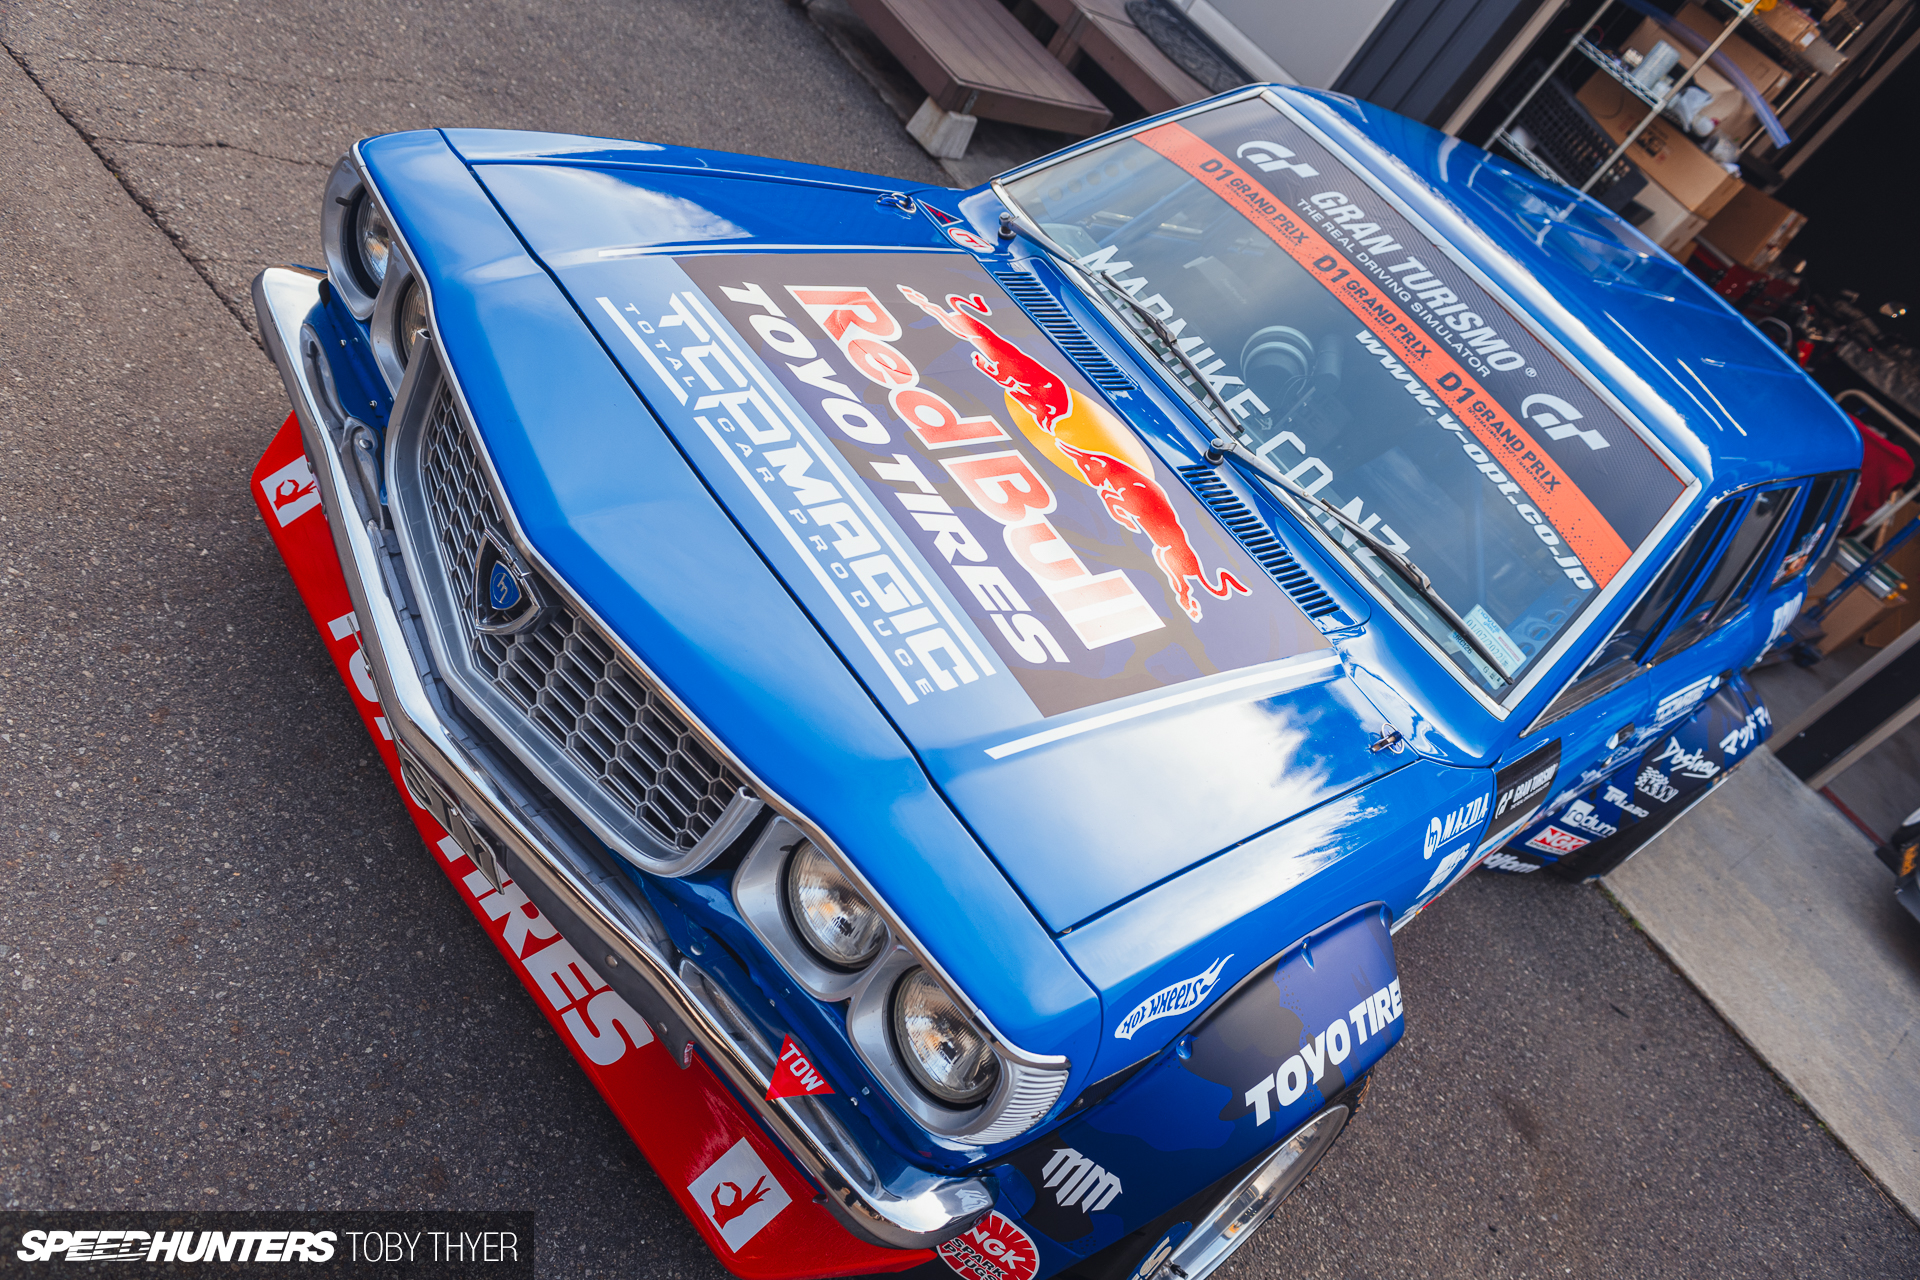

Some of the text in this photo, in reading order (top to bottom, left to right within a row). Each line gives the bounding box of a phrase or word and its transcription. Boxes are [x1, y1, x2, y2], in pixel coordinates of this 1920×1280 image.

[1199, 158, 1310, 245] D1 GRAND PRIX
[1296, 198, 1491, 378] THE REAL DRIVING SIMULATOR
[1309, 190, 1526, 372] GRAN TURISMO
[1312, 255, 1432, 360] D1 GRAND PRIX
[718, 281, 1071, 664] TOYO TIRES
[785, 284, 1167, 651] Red Bull
[1354, 329, 1595, 590] www.v-opt.co.jp
[1436, 371, 1562, 492] D1 GRAND PRIX
[624, 302, 935, 696] TOTAL CAR PRODUCE
[1440, 792, 1490, 842] MAZDA
[1536, 828, 1584, 852] NGK
[781, 1042, 825, 1092] TOW
[1120, 1005, 1148, 1035] HOT
[1243, 974, 1404, 1128] TOYO TIRE
[951, 1236, 1009, 1279] SPARK
[963, 1226, 1026, 1270] NGK
